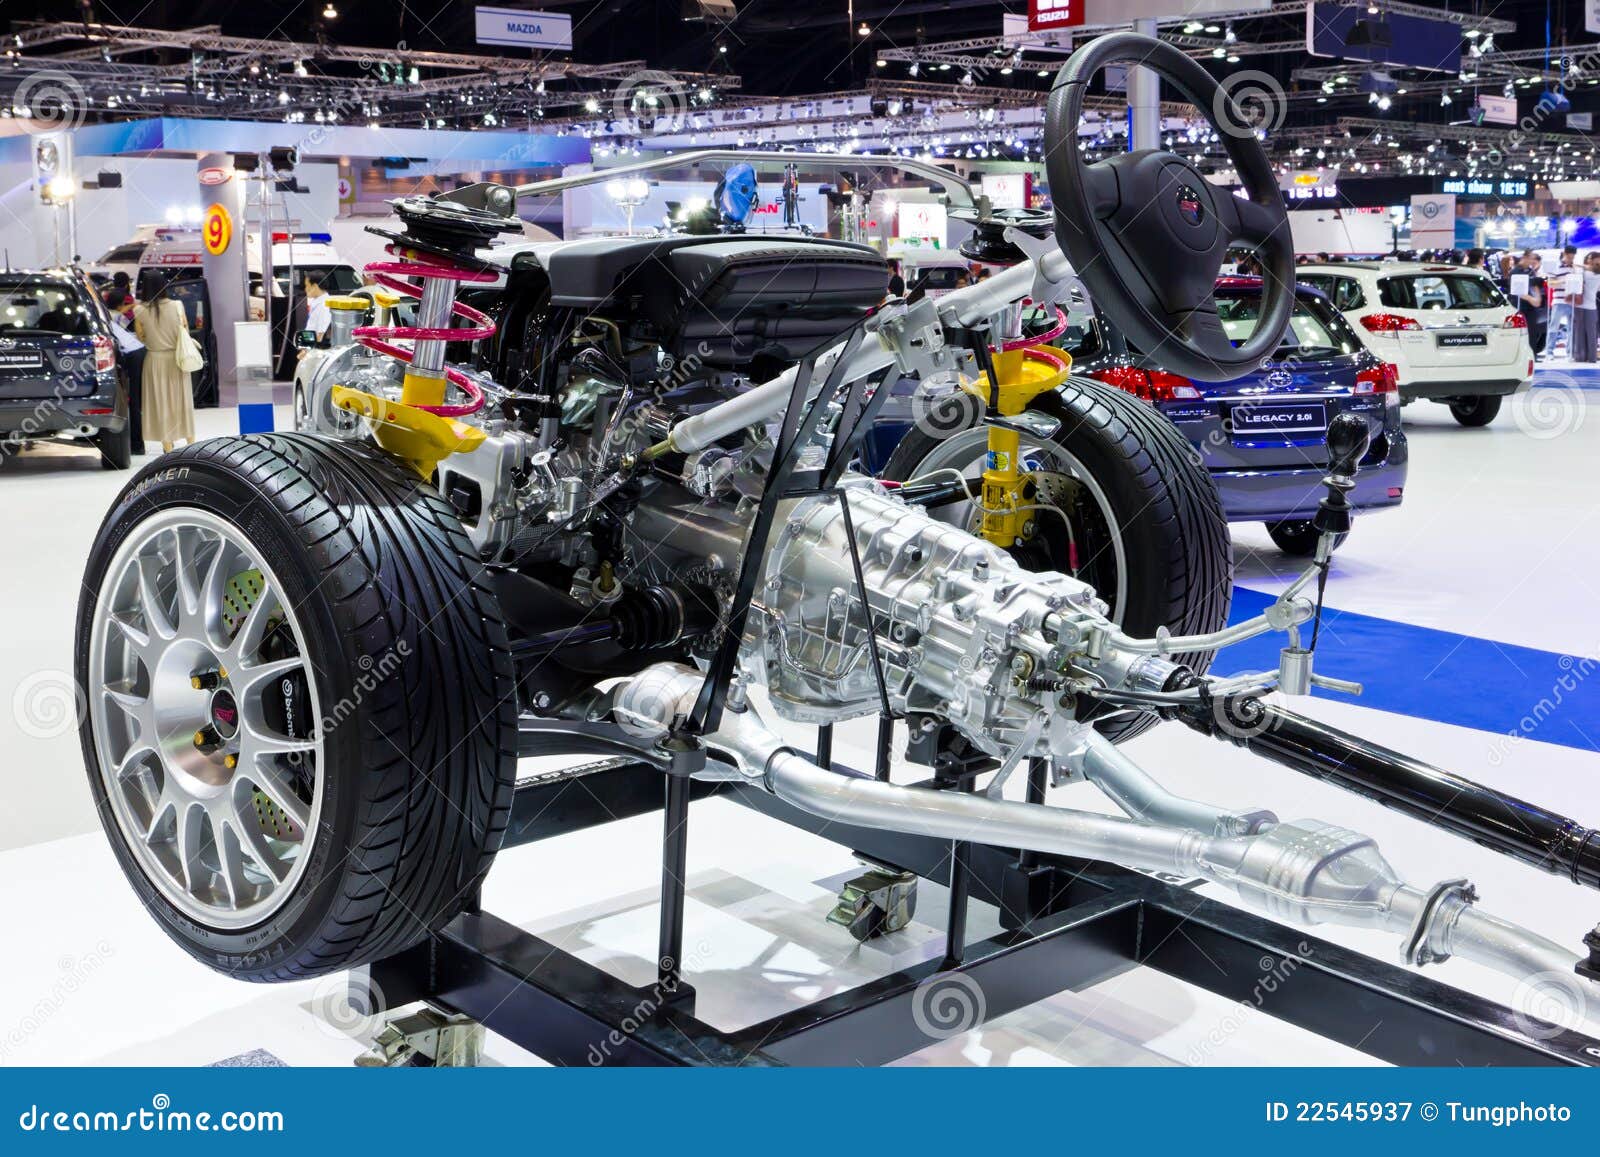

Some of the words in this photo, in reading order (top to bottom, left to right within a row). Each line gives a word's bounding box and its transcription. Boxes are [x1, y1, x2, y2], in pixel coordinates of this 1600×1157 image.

[1037, 10, 1069, 23] ISUZU
[507, 22, 542, 34] MAZDA
[1443, 180, 1466, 193] next
[1467, 180, 1493, 195] show
[210, 215, 223, 249] 9
[1245, 414, 1294, 423] LEGACY
[1296, 413, 1313, 421] 2.0i
[124, 467, 190, 505] FALKEN
